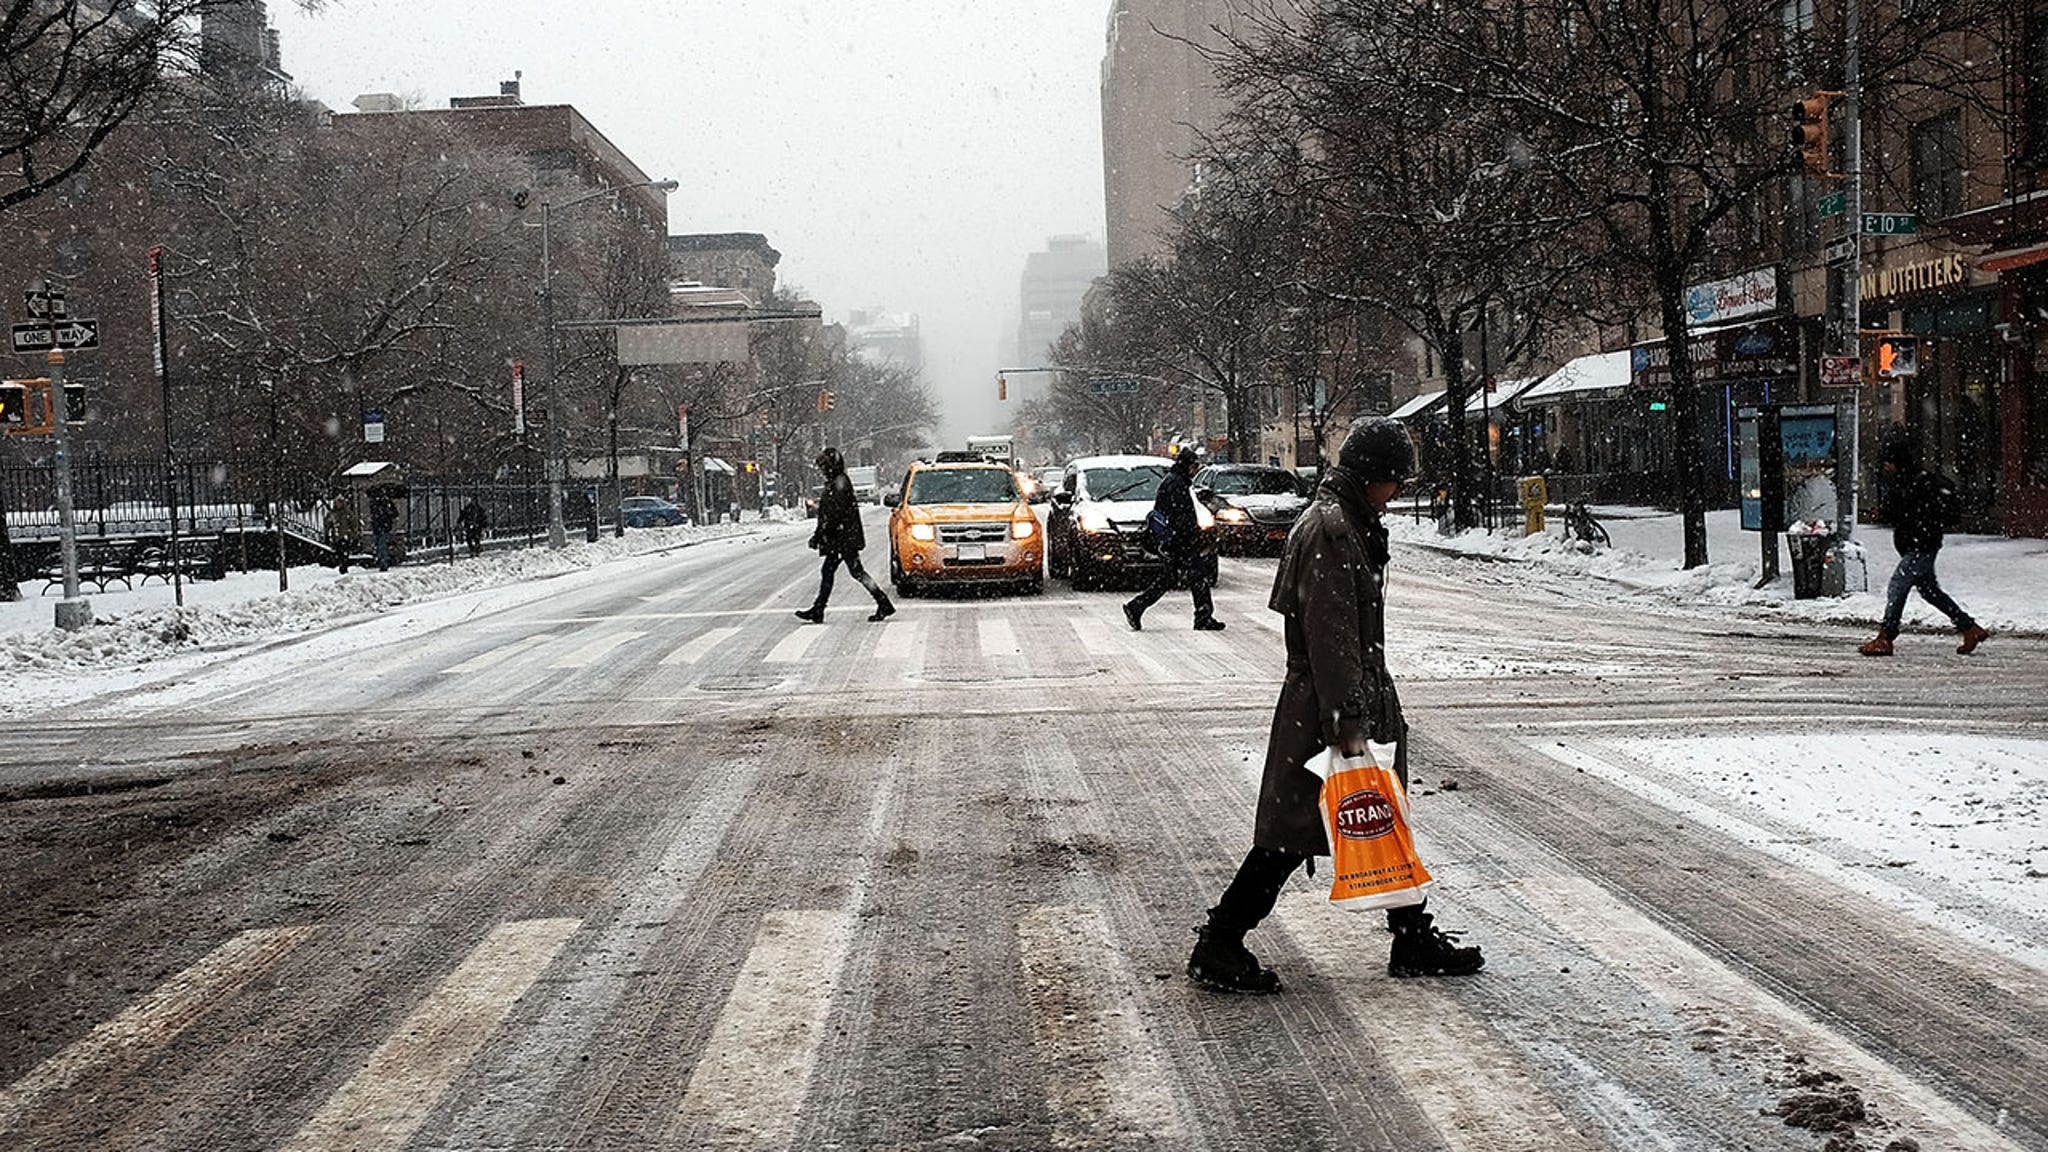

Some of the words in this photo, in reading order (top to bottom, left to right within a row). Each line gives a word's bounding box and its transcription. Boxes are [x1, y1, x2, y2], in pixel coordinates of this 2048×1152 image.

[1866, 216, 1874, 232] E
[1880, 215, 1895, 232] 10
[1900, 217, 1909, 226] ST
[1880, 254, 1963, 297] OUTFITTERS
[24, 331, 48, 343] ONE
[60, 329, 85, 341] WAY
